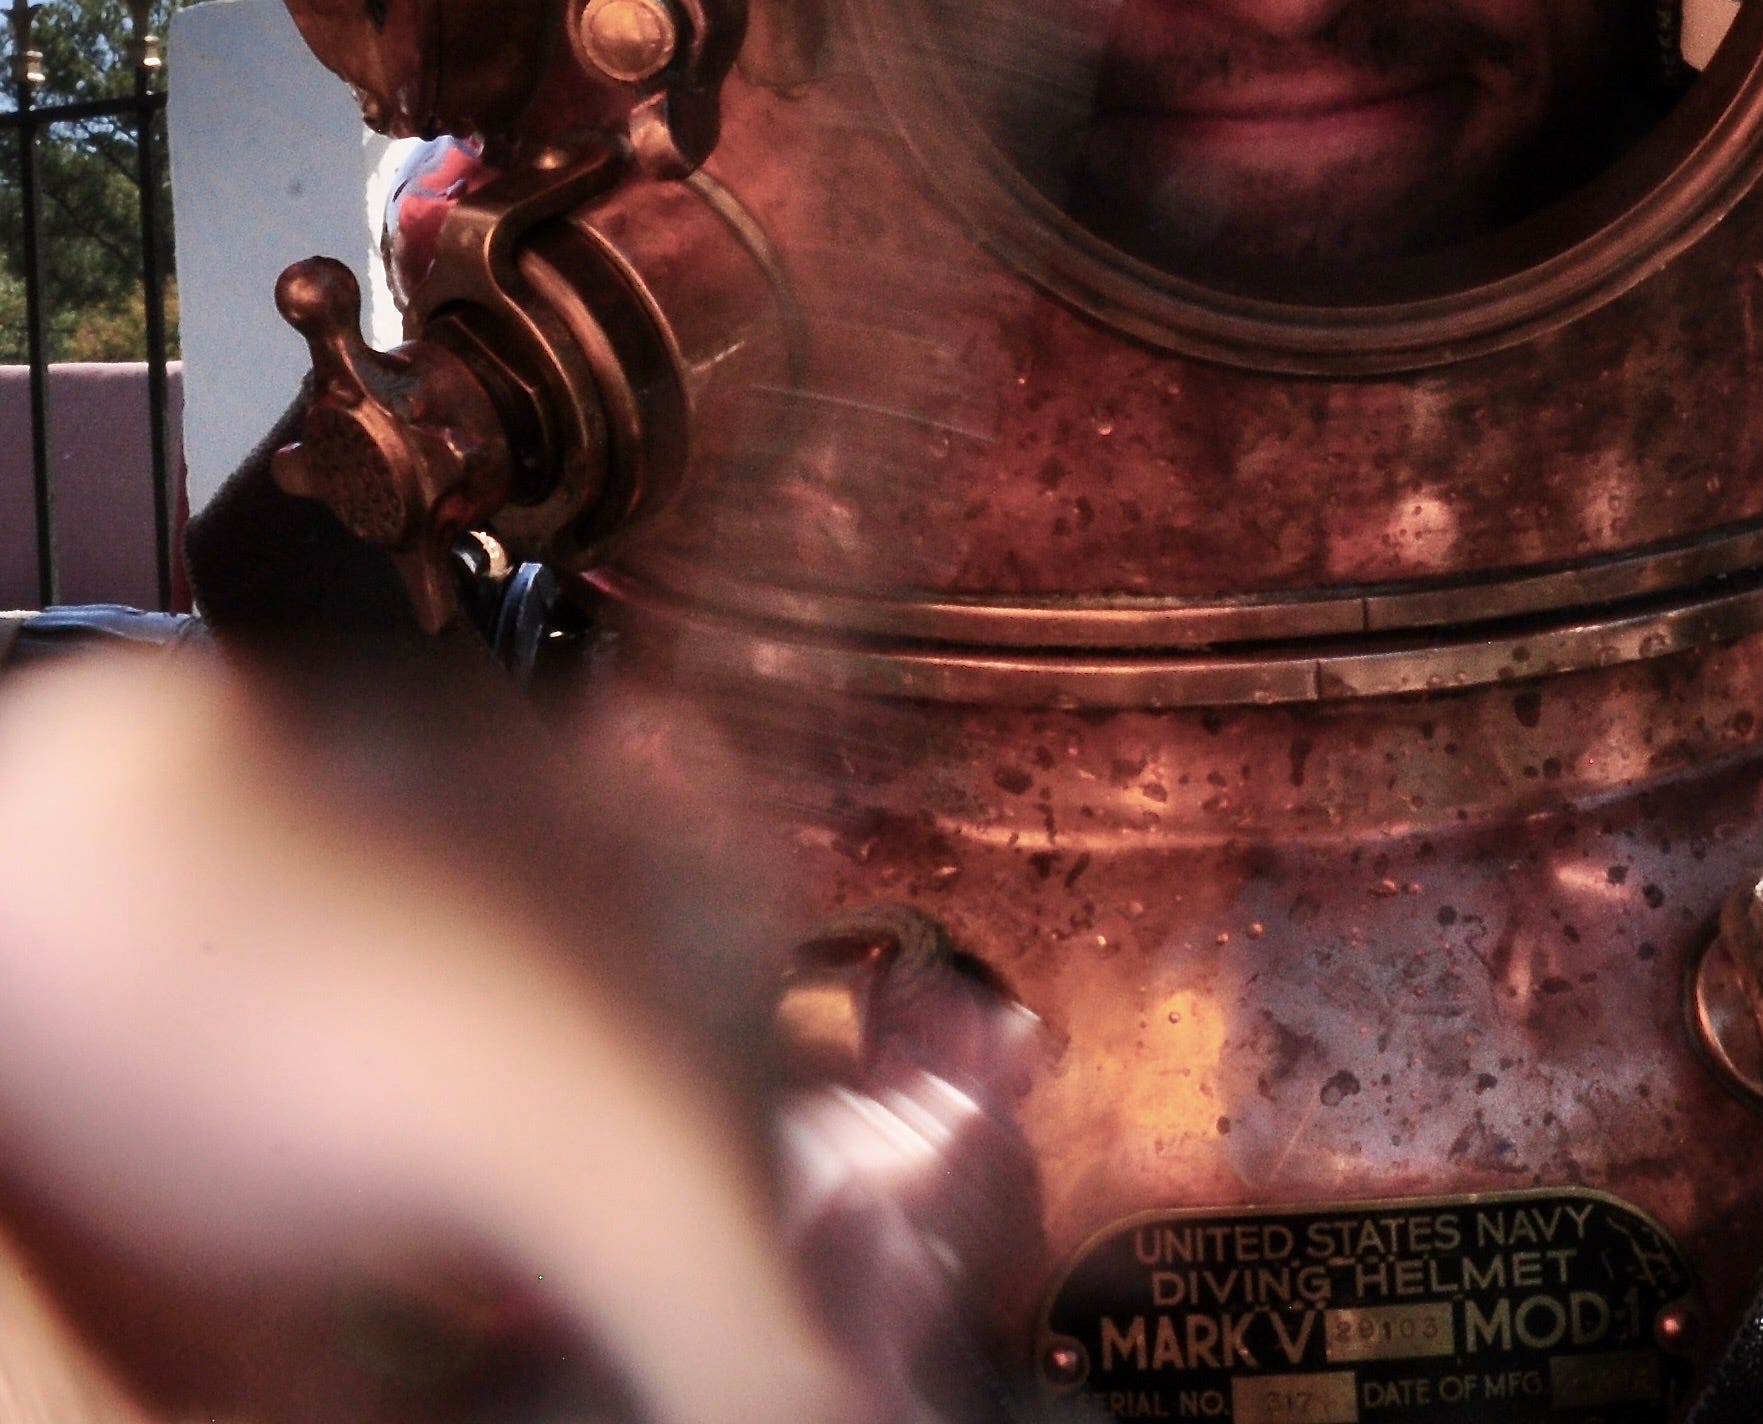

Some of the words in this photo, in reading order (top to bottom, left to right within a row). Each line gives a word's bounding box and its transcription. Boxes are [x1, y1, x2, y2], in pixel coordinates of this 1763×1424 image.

[1134, 1223, 1294, 1266] UNITED
[1306, 1213, 1462, 1259] STATES
[1476, 1204, 1597, 1248] NAVY
[1151, 1265, 1333, 1307] DIVING
[1355, 1247, 1579, 1297] HELMET
[1101, 1312, 1258, 1373] MARK
[1266, 1306, 1314, 1366] V
[1362, 1376, 1431, 1409] DATE
[1437, 1372, 1477, 1402] OF
